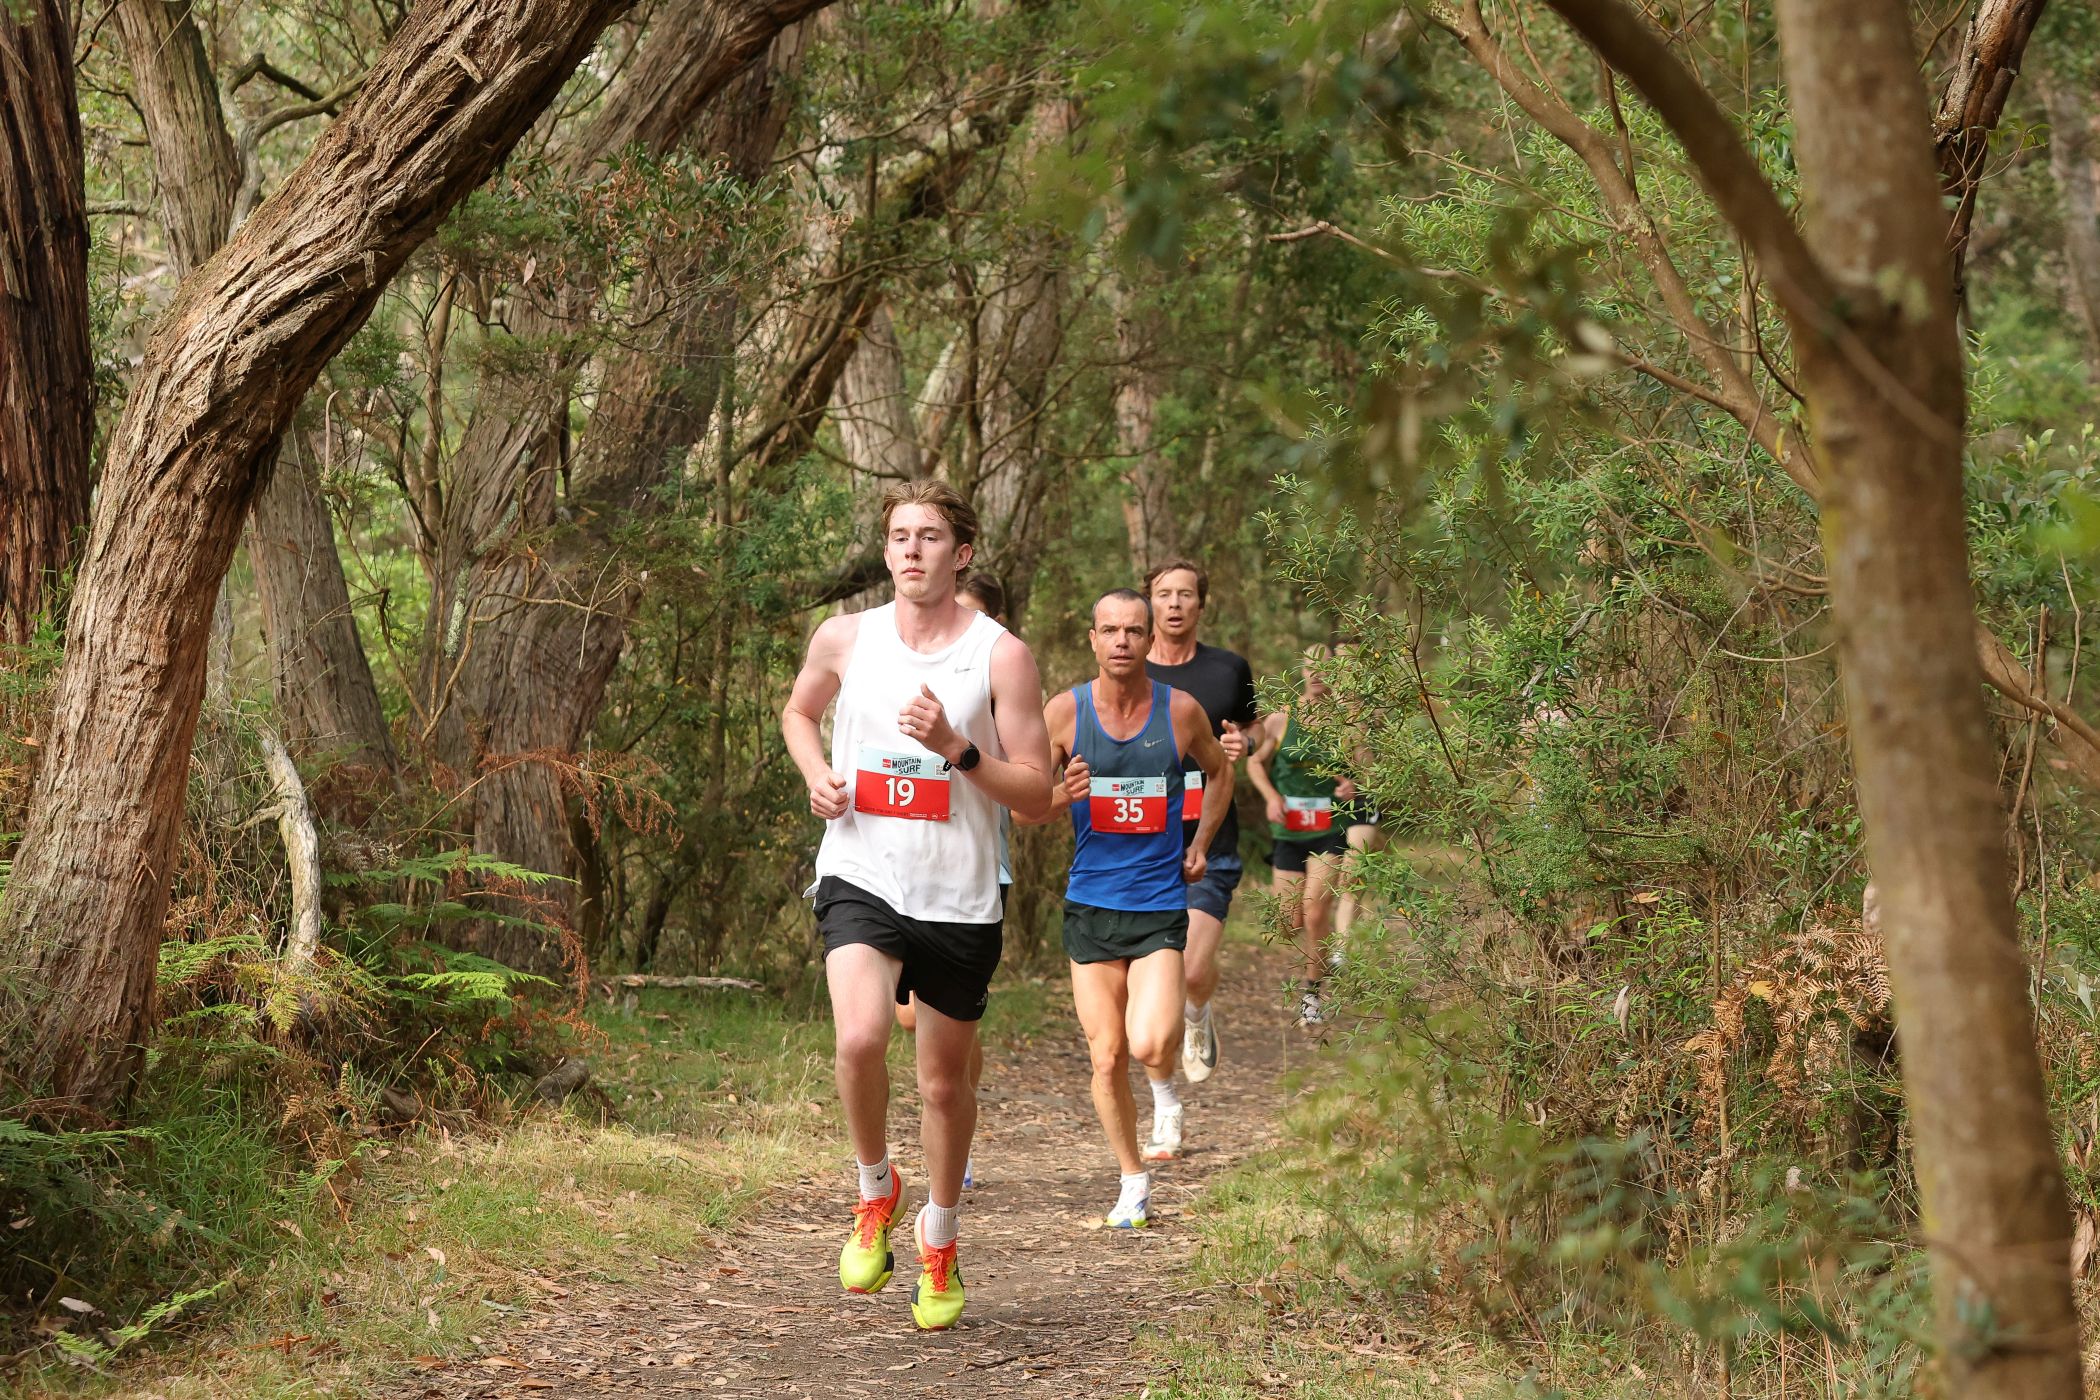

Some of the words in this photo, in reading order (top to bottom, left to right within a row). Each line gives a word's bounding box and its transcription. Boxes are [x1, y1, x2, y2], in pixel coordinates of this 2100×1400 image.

[892, 757, 921, 769] MOUNTAIN
[898, 765, 921, 774] SURF
[885, 777, 915, 807] 19
[1120, 779, 1144, 791] MOUNTAIN
[1113, 798, 1144, 823] 35
[1300, 810, 1316, 826] 31
